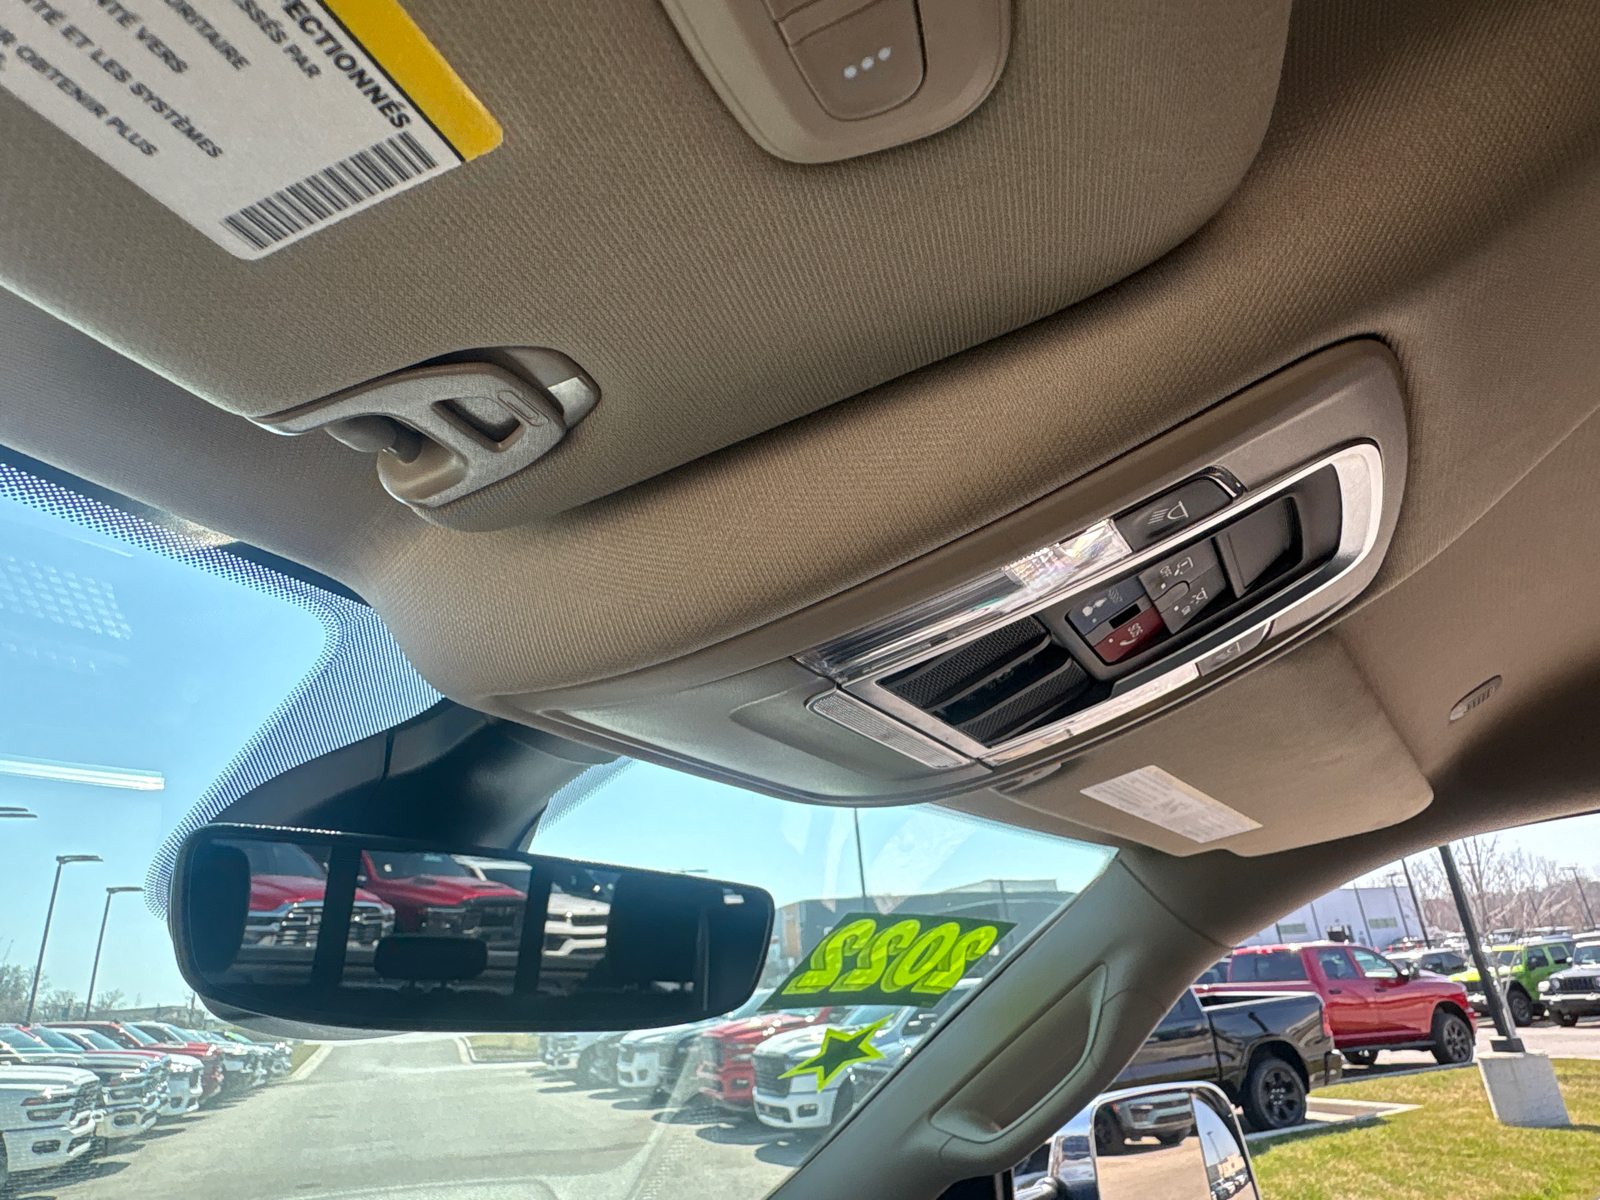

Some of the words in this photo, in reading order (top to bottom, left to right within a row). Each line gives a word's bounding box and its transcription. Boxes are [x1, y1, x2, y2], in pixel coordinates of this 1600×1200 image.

[136, 25, 188, 73] VERS
[283, 44, 321, 78] PAR
[16, 45, 108, 118] OBTENIR
[105, 116, 158, 156] PLUS
[60, 25, 95, 48] ET
[90, 49, 132, 83] LES
[129, 82, 223, 158] SYSTÈMES
[1127, 622, 1144, 638] SOS
